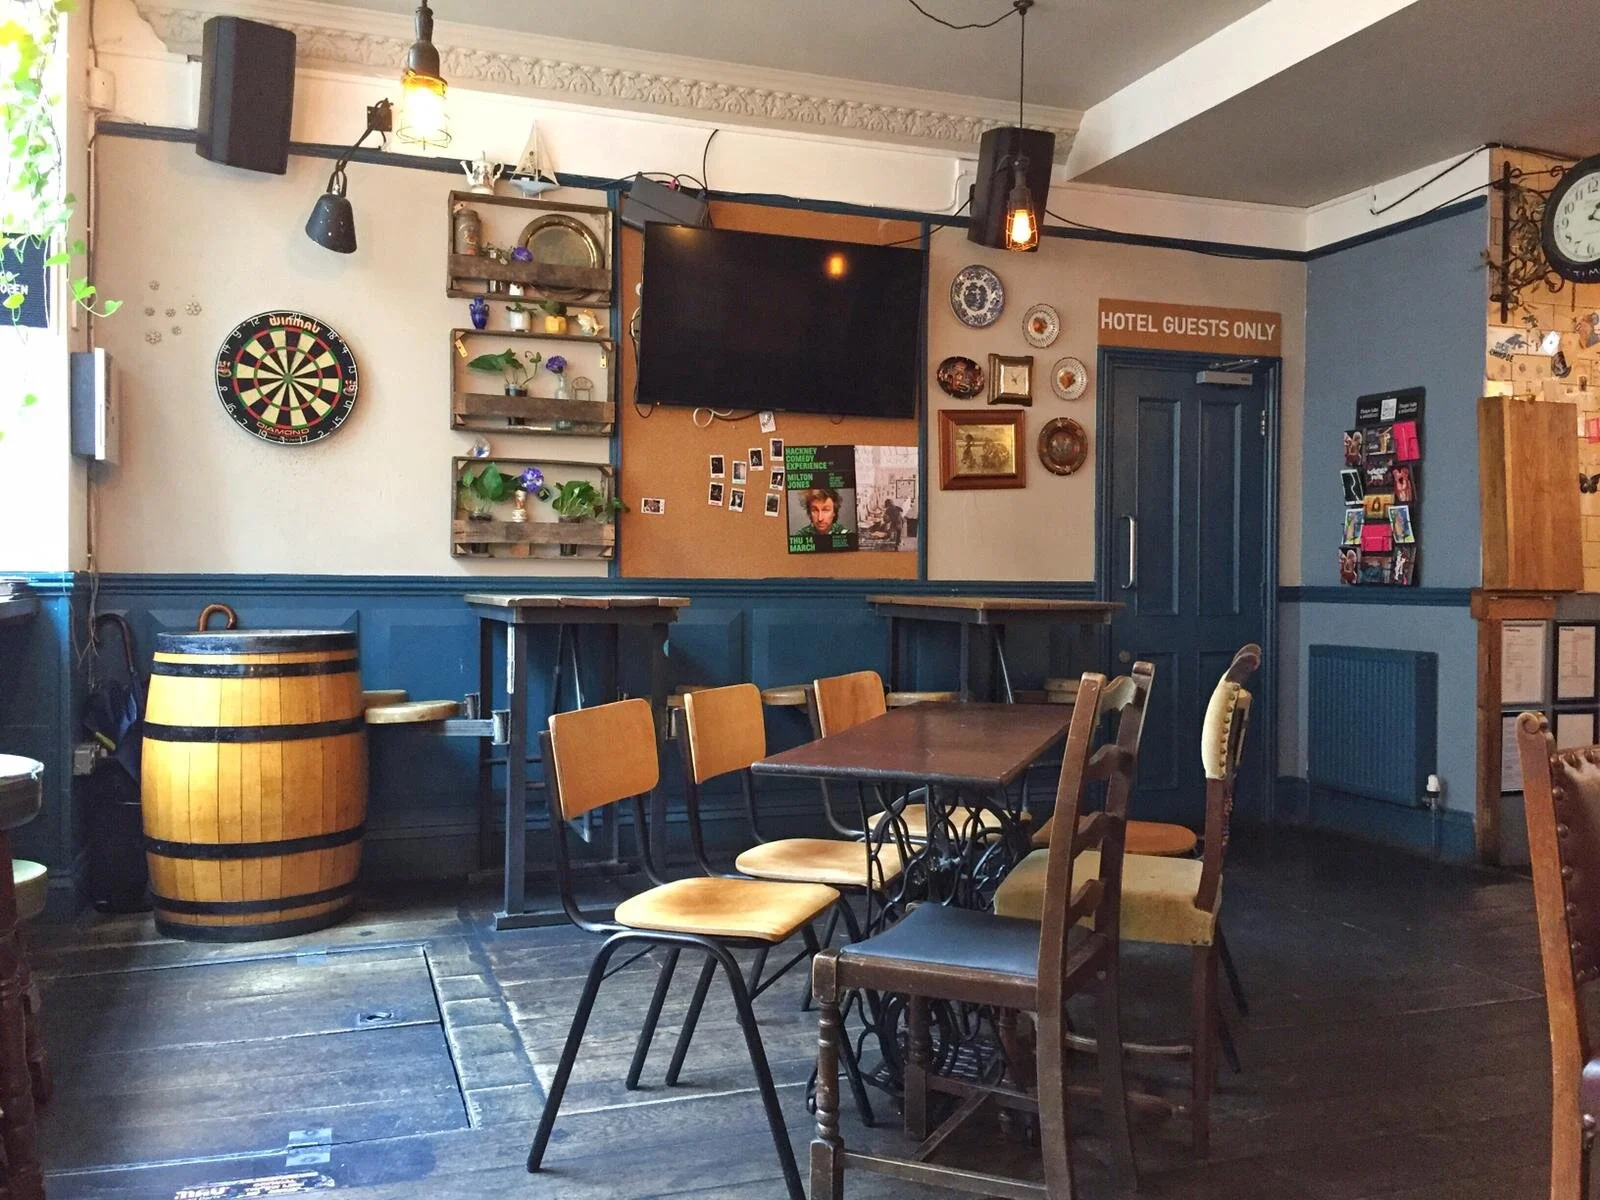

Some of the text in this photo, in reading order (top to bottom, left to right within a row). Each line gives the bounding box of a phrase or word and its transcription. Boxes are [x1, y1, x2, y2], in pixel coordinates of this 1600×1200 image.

[1588, 180, 1599, 193] 12
[1575, 190, 1584, 200] 11
[1564, 202, 1574, 214] 10
[1562, 218, 1569, 228] 9
[1101, 311, 1276, 341] HOTEL GUESTS ONLY
[256, 422, 310, 436] DIAMOND
[786, 462, 827, 470] EXPERIENCE
